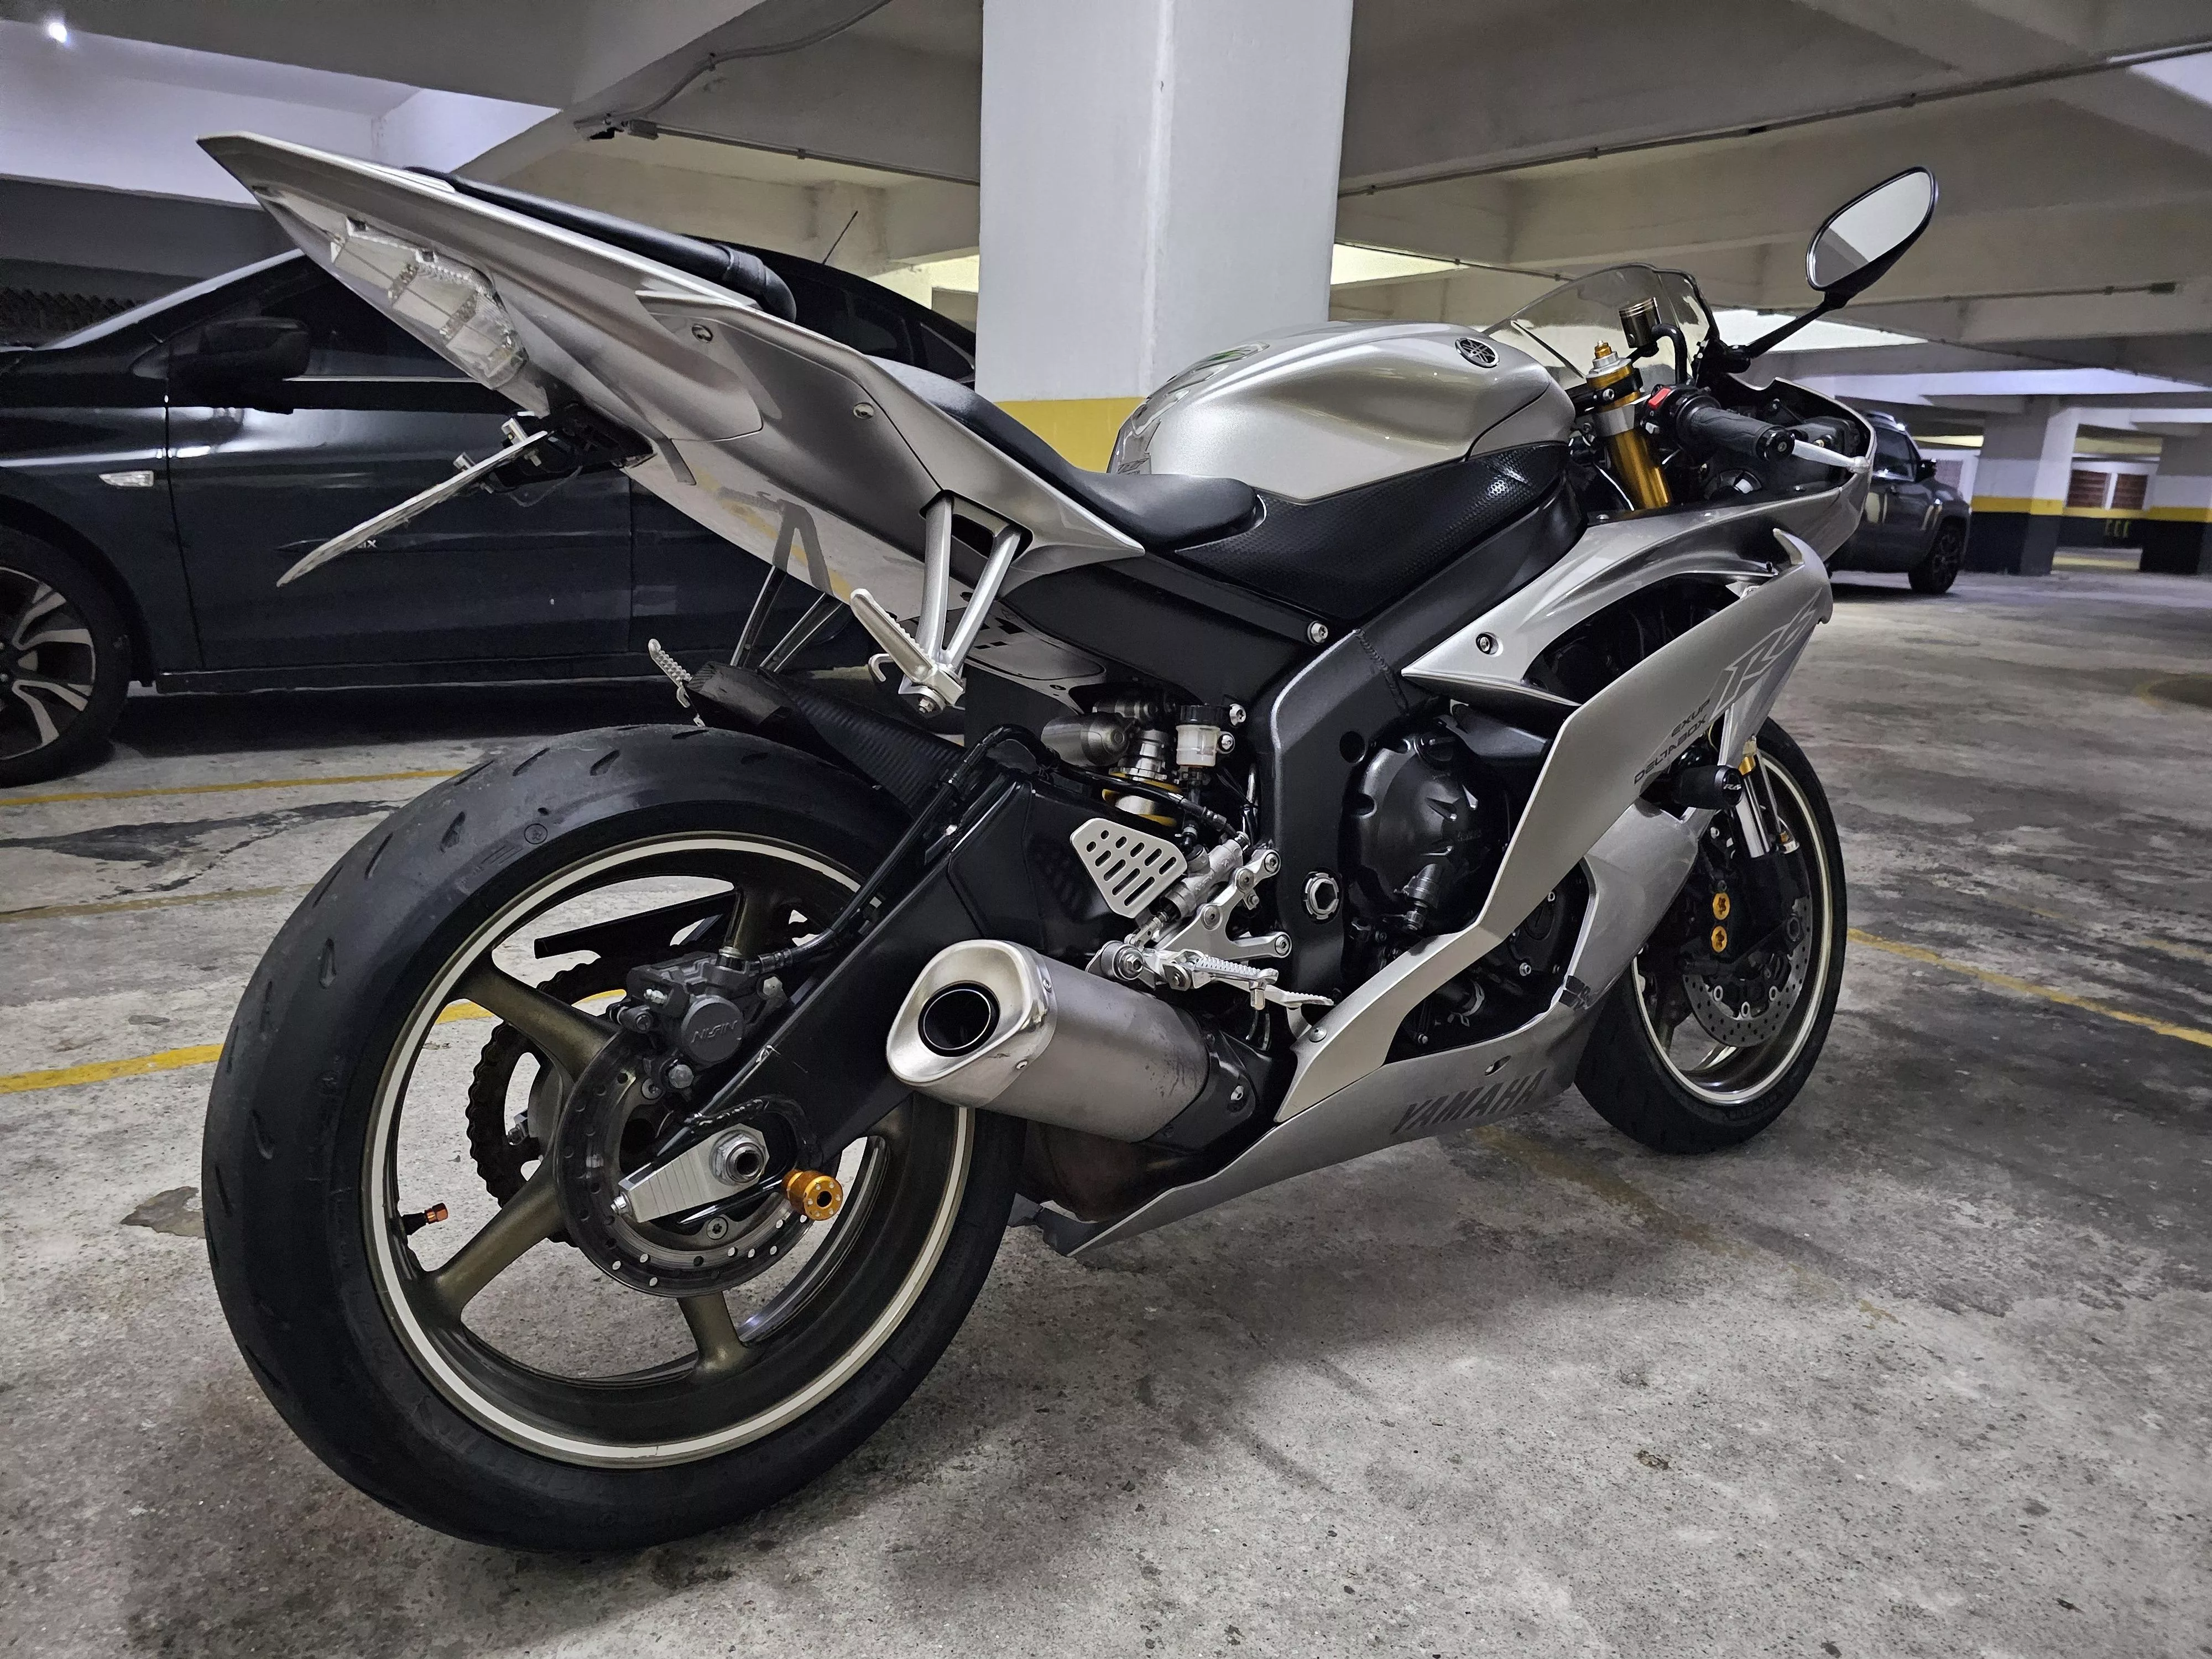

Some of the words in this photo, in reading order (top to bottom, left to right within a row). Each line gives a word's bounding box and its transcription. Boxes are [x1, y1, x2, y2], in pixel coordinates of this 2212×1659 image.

[1634, 714, 1707, 784] DELTABOX
[1671, 698, 1710, 737] EXUP
[1390, 1068, 1547, 1134] YAMAHA
